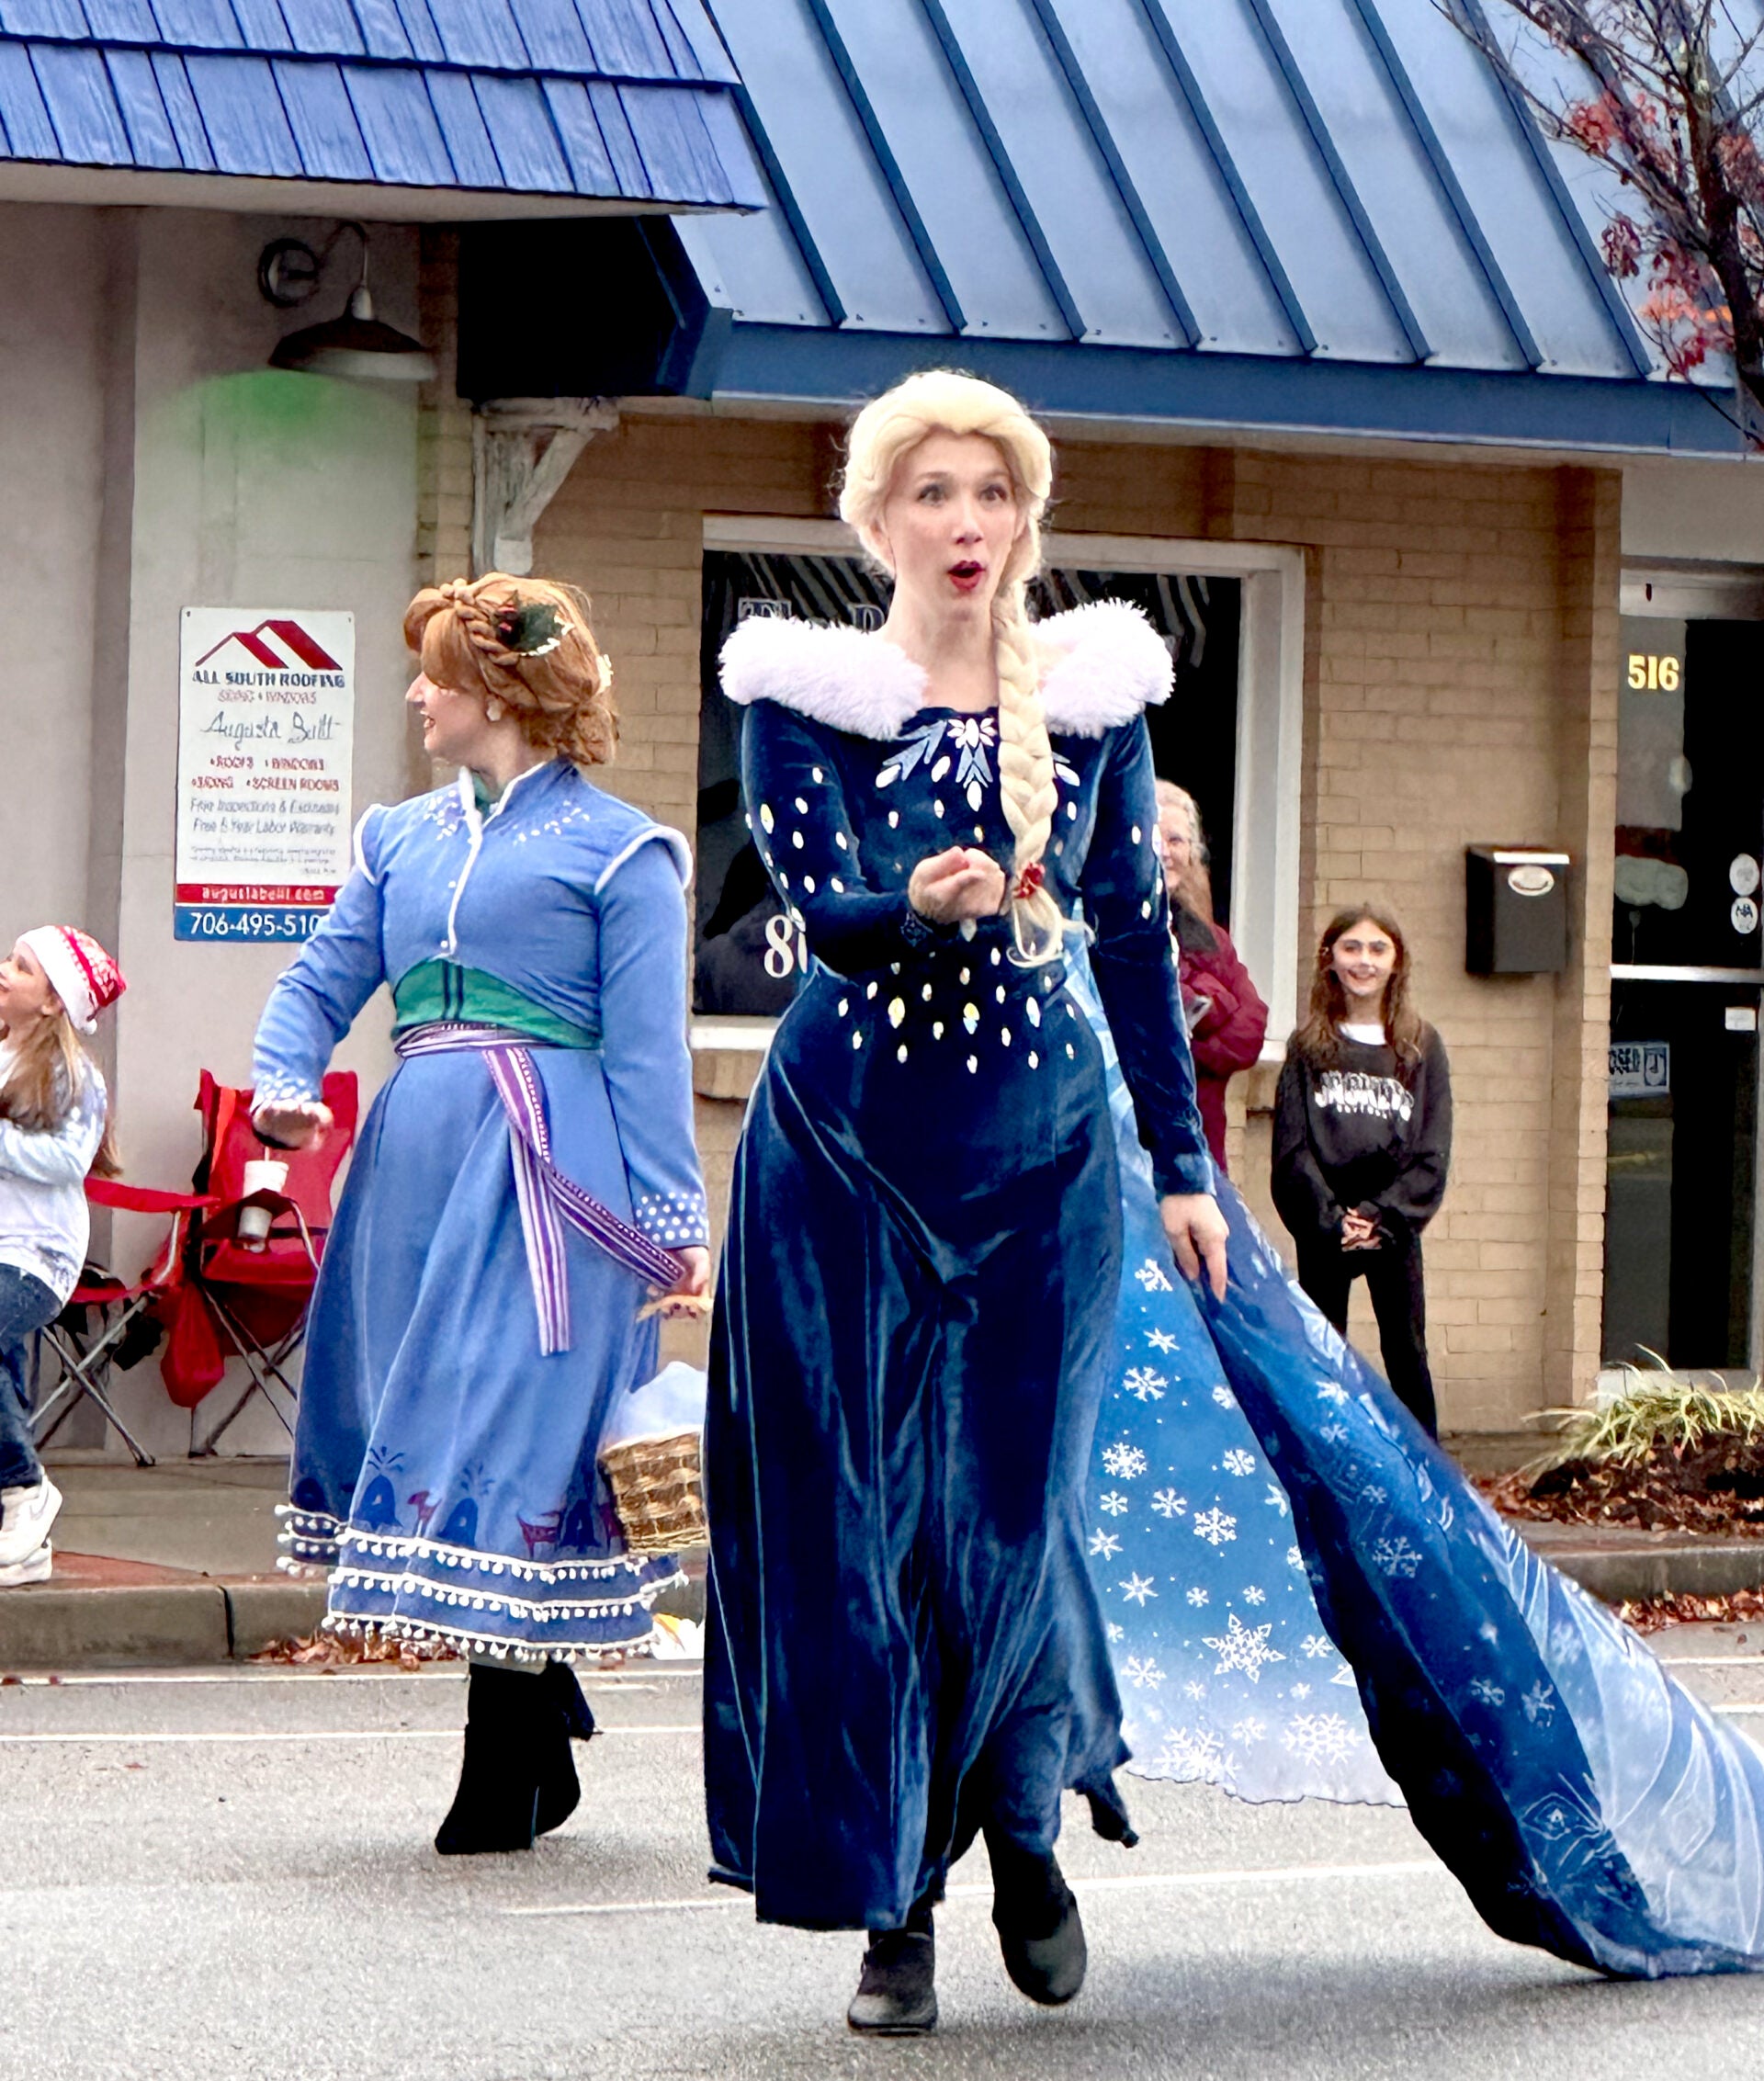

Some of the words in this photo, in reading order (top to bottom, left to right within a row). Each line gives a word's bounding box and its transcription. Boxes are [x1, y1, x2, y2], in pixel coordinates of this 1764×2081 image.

[192, 670, 220, 684] ALL
[225, 672, 276, 687] SOUTH
[279, 673, 345, 688] ROOFING
[1627, 654, 1679, 692] 516
[199, 710, 282, 752] Augusta
[189, 911, 323, 936] 706-495-510
